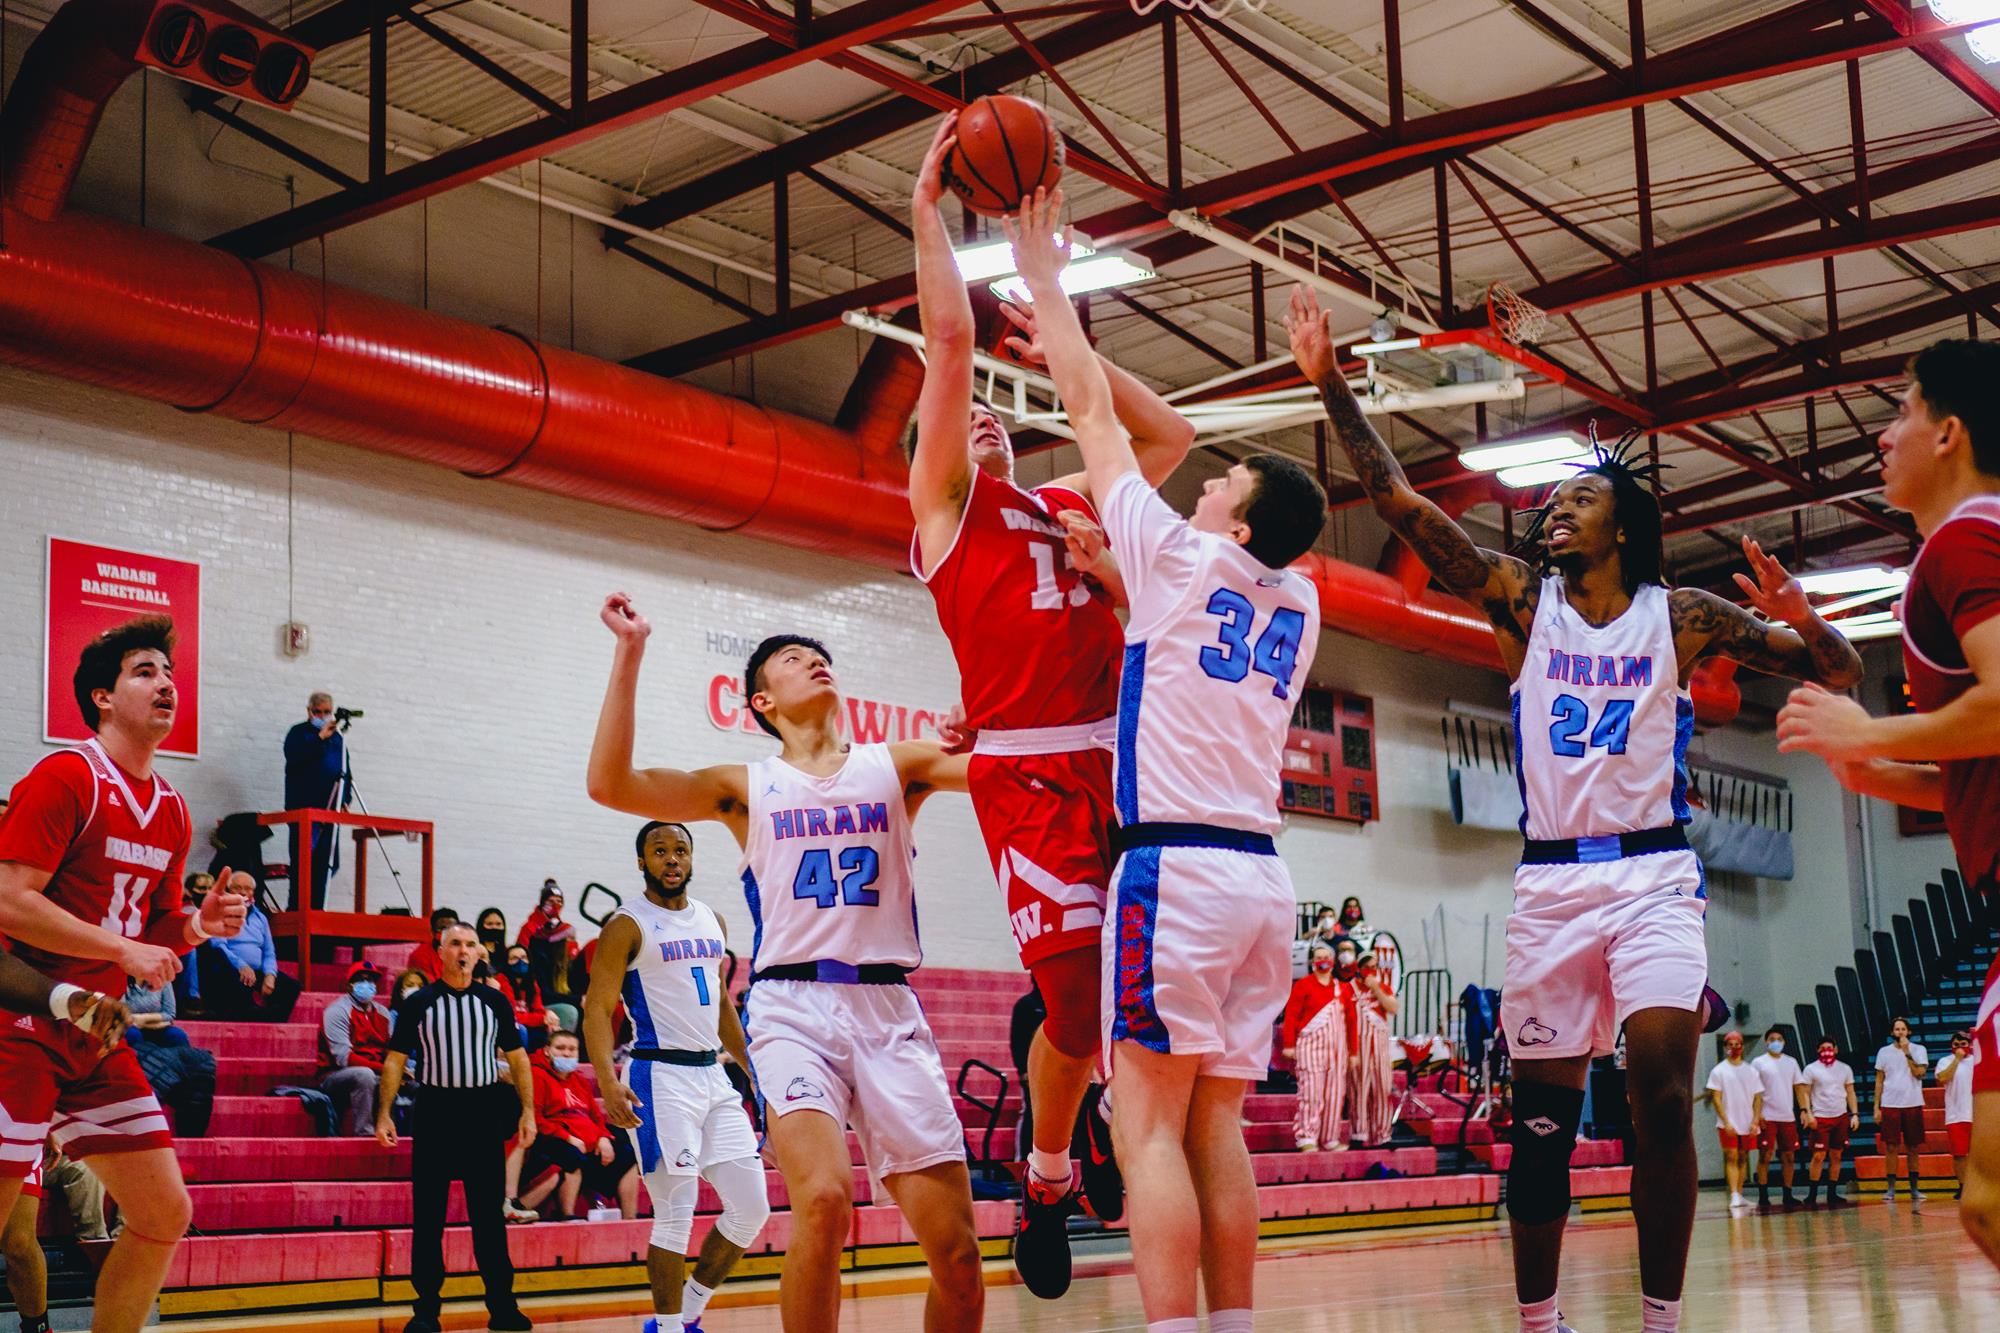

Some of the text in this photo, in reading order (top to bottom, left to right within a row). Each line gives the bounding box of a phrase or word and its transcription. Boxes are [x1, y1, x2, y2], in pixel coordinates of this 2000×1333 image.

[81, 578, 170, 606] BASKETBALL
[97, 562, 157, 586] WABASH
[1199, 587, 1306, 700] 34
[1547, 649, 1652, 687] HIRAM
[1550, 693, 1635, 759] 24
[770, 802, 889, 840] HIRAM
[793, 845, 880, 909] 42
[101, 872, 150, 938] 11
[659, 938, 723, 963] HIRAM
[690, 966, 711, 1006] 1
